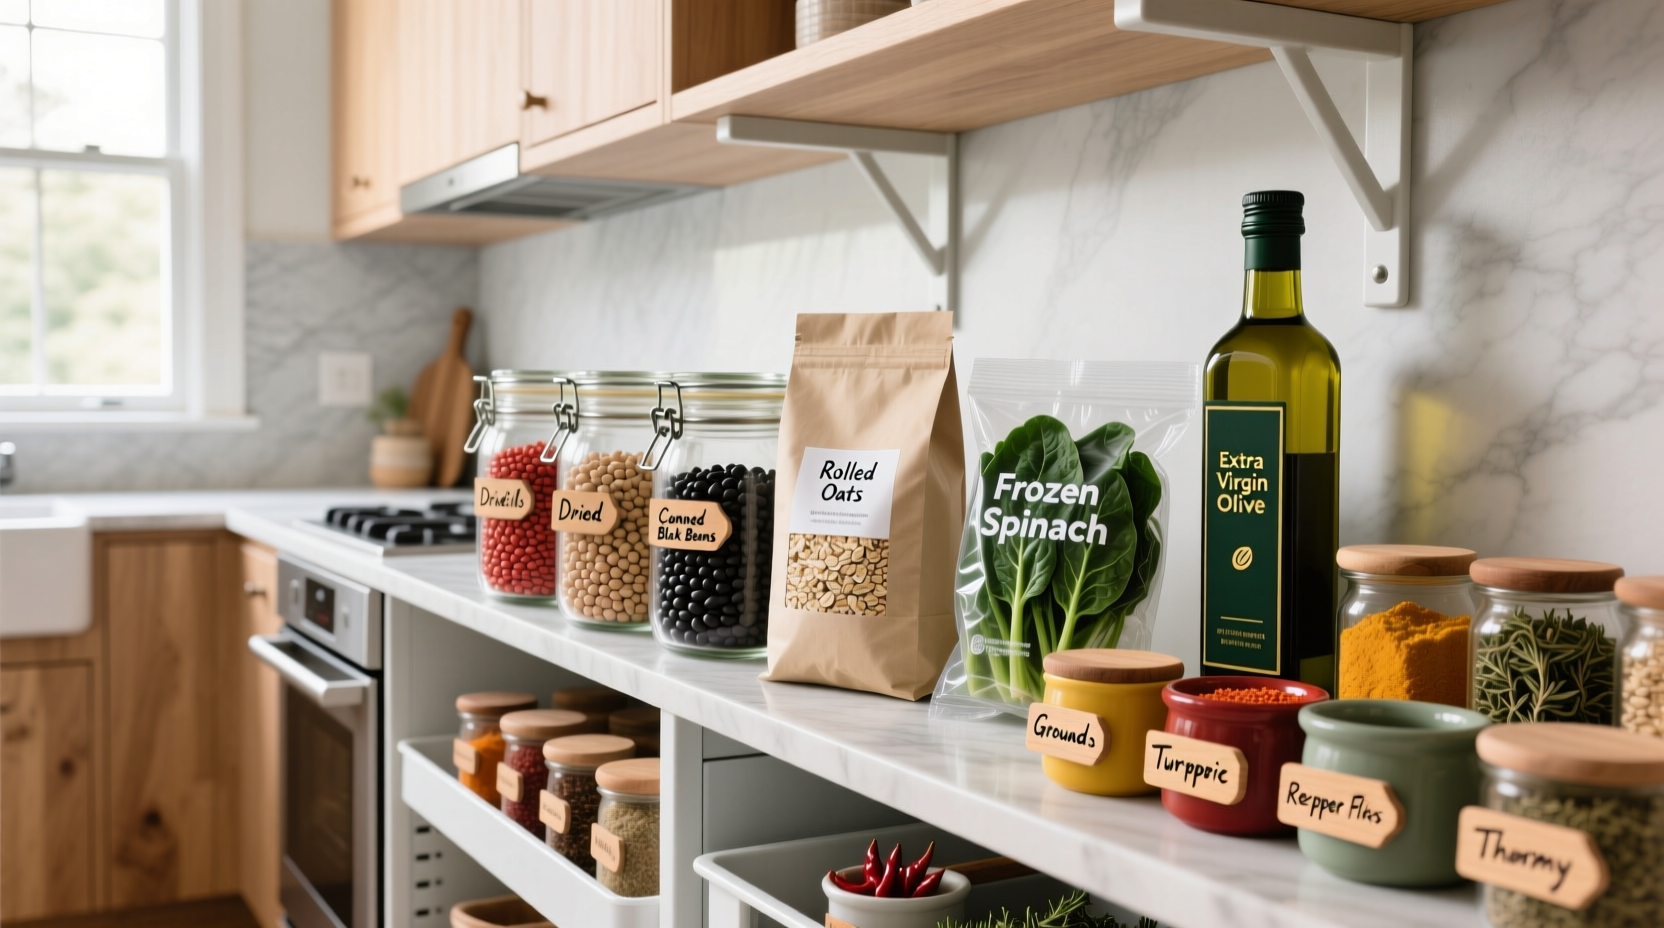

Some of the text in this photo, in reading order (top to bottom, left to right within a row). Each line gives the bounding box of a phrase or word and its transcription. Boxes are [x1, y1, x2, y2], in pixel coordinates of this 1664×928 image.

[819, 460, 879, 481] Rolled
[1219, 451, 1264, 470] Extra
[821, 483, 864, 503] Oats
[993, 472, 1100, 506] Frozen
[1216, 472, 1268, 496] Virgin
[1216, 494, 1266, 515] Olive
[980, 506, 1108, 546] Spinach
